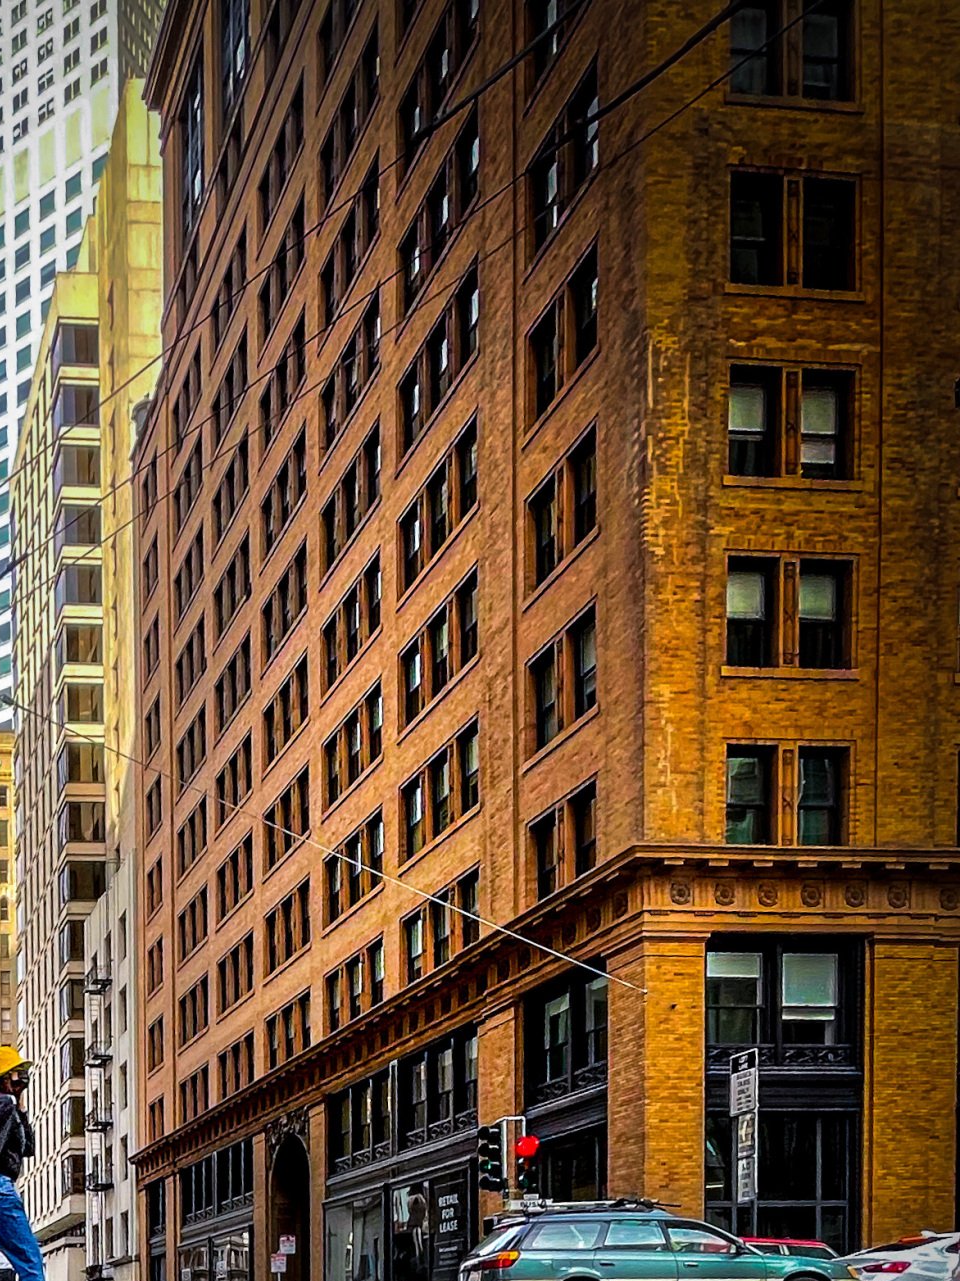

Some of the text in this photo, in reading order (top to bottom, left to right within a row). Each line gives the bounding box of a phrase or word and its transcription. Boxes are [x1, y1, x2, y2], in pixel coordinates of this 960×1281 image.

[438, 1193, 459, 1208] RETAIL
[441, 1207, 455, 1220] FOR
[439, 1219, 458, 1234] LEASE
